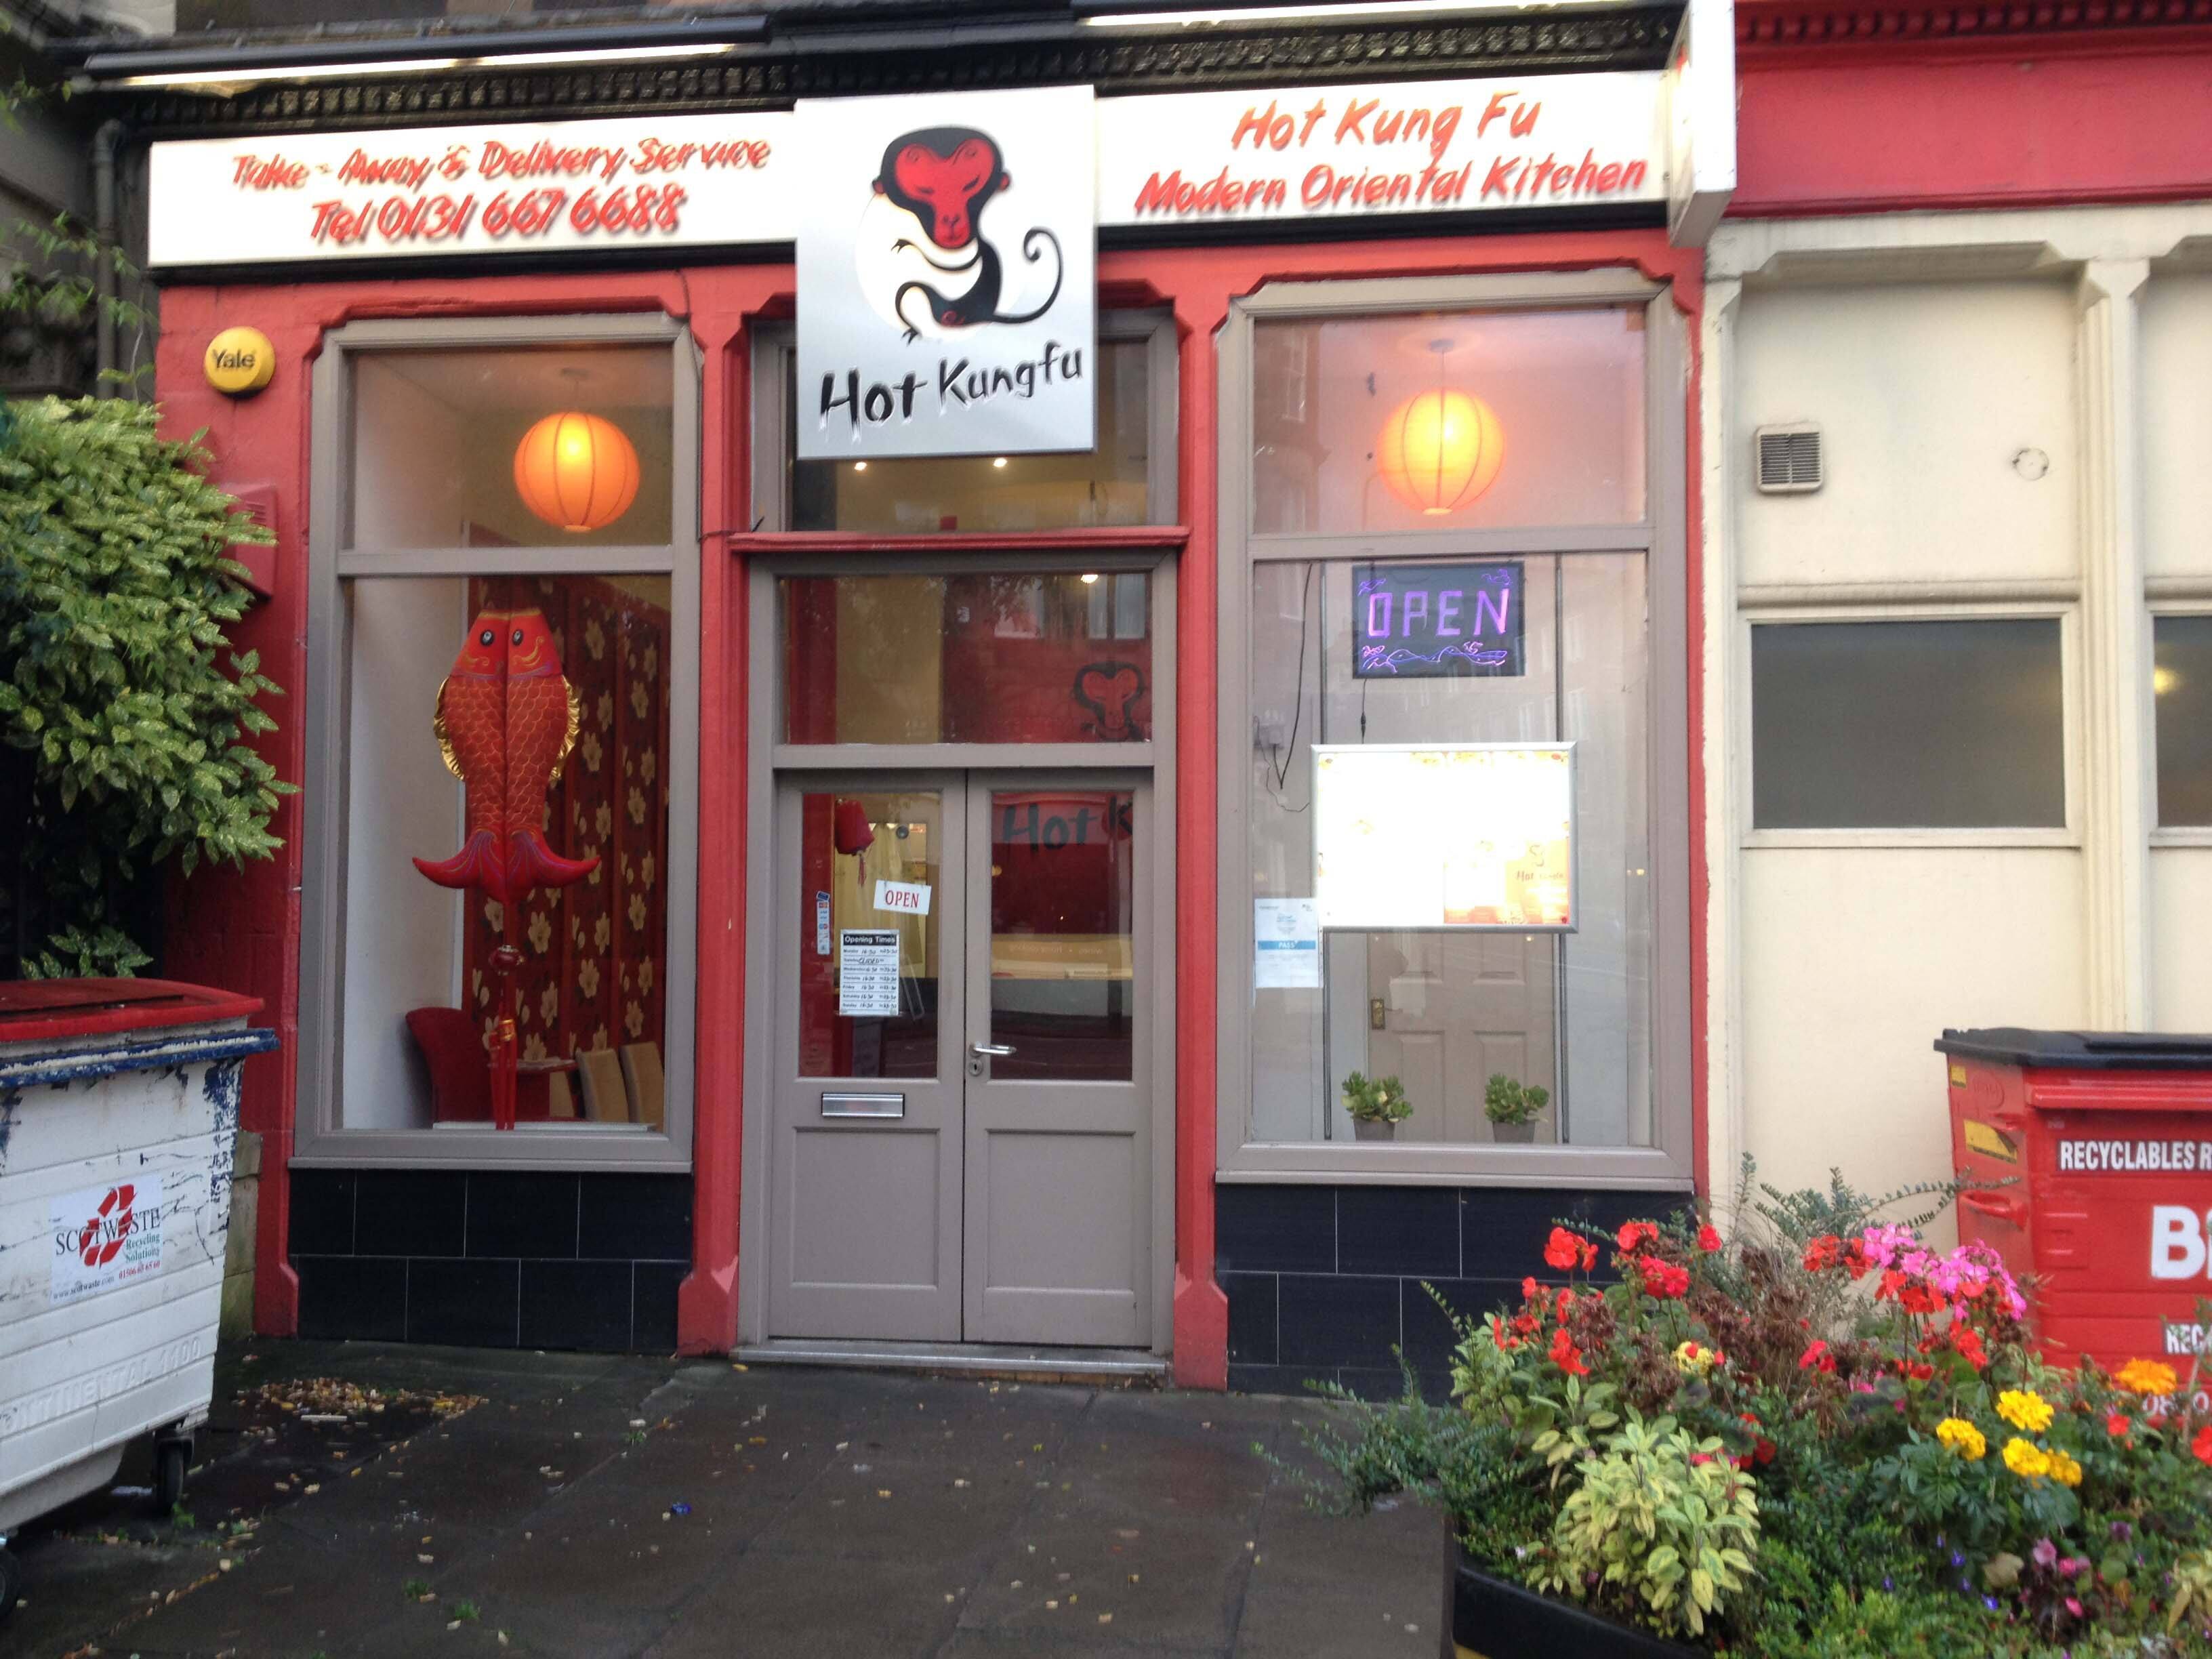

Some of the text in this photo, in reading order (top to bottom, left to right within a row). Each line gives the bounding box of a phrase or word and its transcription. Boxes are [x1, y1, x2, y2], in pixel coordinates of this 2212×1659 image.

[1231, 91, 1542, 168] Hot Kung Fu
[233, 153, 309, 191] Take
[337, 148, 435, 193] Away
[478, 140, 628, 184] Delivery
[629, 138, 771, 173] Service
[1134, 148, 1649, 216] Modern Oriental Kitchen
[310, 183, 689, 247] Tel 0131 667 6688
[212, 348, 256, 369] Yale
[820, 340, 1082, 442] Hot Kungfu
[1367, 588, 1510, 638] OPEN
[1003, 802, 1099, 855] Hot
[885, 890, 920, 908] OPEN
[844, 936, 873, 944] Opening
[2060, 1141, 2195, 1170] RECYCLABLES
[56, 1207, 161, 1256] SCOTWASTE
[125, 1233, 160, 1250] Recycling
[125, 1247, 160, 1264] Solutions
